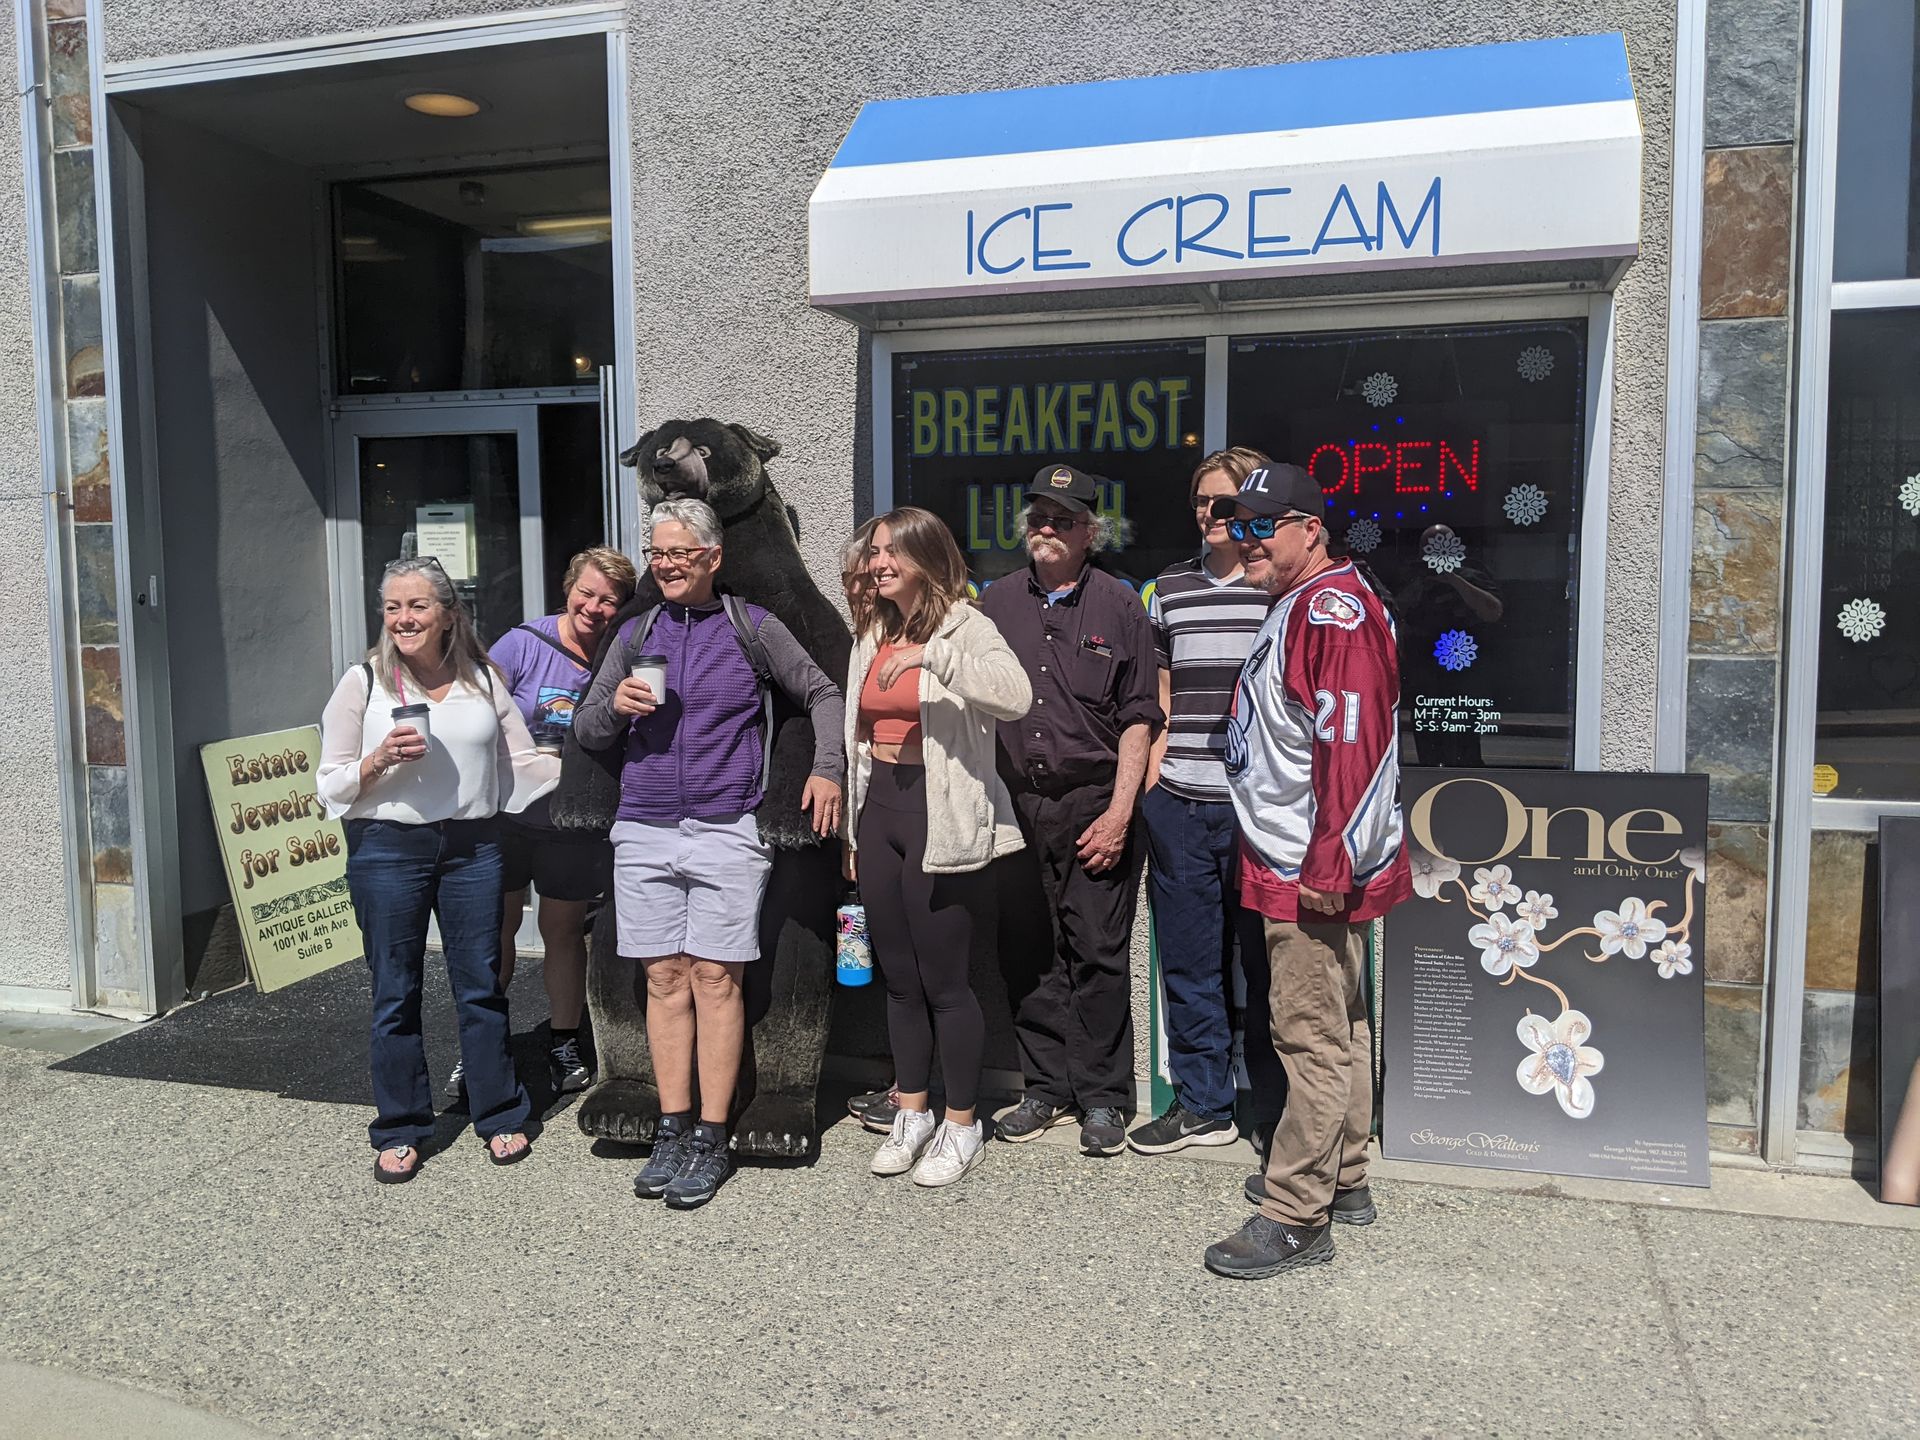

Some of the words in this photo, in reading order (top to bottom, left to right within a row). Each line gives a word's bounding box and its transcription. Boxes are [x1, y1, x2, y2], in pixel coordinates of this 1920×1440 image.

[967, 202, 1091, 275] ICE
[1117, 177, 1441, 267] CREAM
[911, 377, 1190, 456] BREAKFAST
[1308, 440, 1479, 494] OPEN
[967, 484, 1126, 552] LUH
[1315, 689, 1360, 743] 21
[1414, 708, 1441, 719] M-F:
[1444, 708, 1468, 719] 7am
[1415, 695, 1456, 706] Current
[1458, 695, 1494, 706] Hours:
[1415, 721, 1439, 732] S-S:
[1473, 722, 1498, 735] 2pm
[226, 748, 309, 786] Estate
[1410, 778, 1683, 865] One
[240, 846, 280, 889] for
[286, 830, 341, 867] Sale
[1573, 864, 1600, 875] and
[1605, 864, 1640, 880] Only
[258, 916, 306, 941] ANTIQUE
[307, 900, 354, 924] GALLERY
[273, 935, 296, 952] 1001
[297, 931, 311, 946] W.
[313, 925, 328, 942] 4th
[330, 918, 349, 934] Ave
[297, 943, 323, 960] Suite
[325, 941, 333, 951] B
[1410, 1129, 1466, 1150] George
[1467, 1132, 1540, 1153] Walton's
[1604, 1145, 1624, 1153] George
